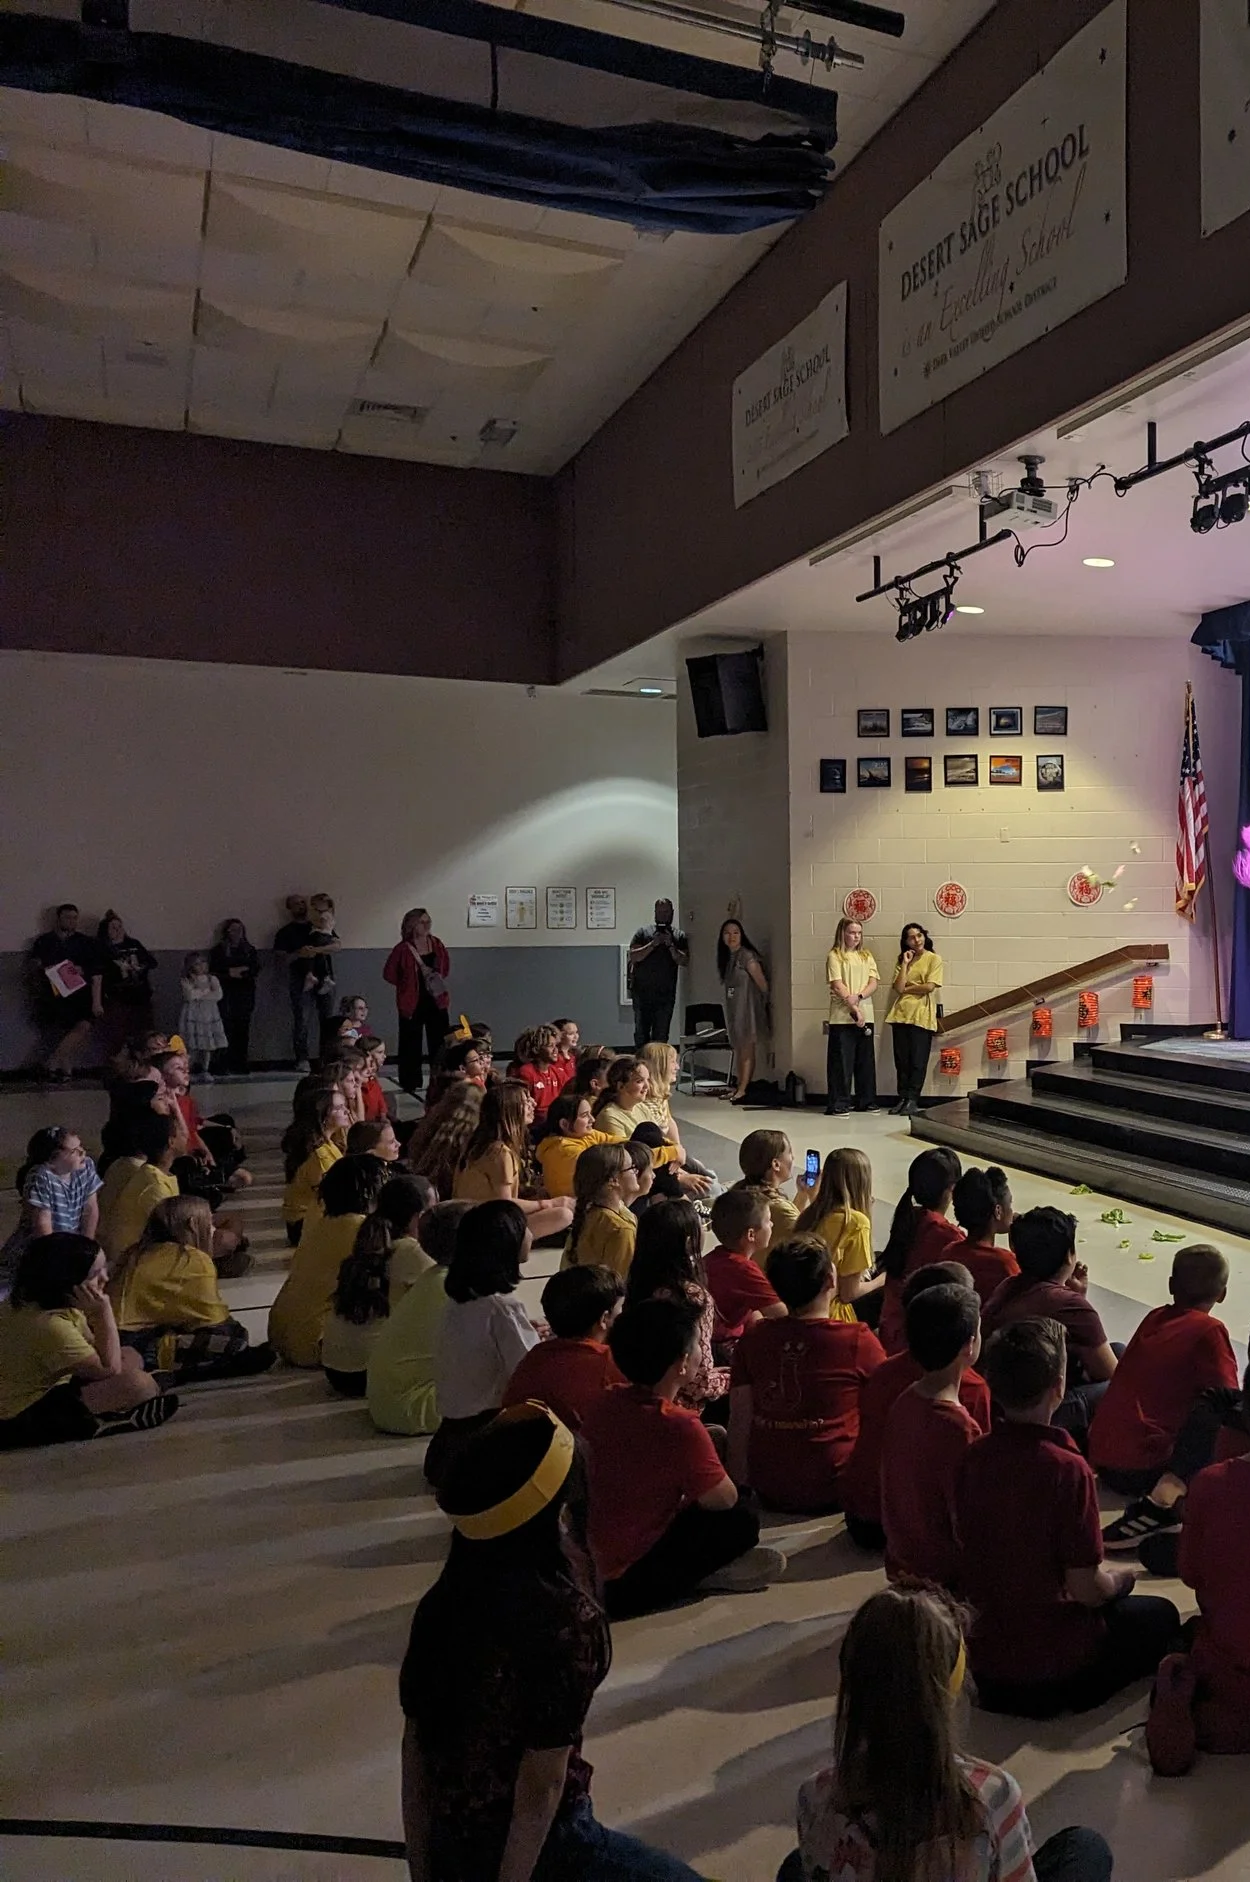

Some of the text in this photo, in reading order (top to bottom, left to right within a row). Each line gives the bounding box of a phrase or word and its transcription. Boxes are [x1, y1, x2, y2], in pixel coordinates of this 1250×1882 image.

[901, 123, 1090, 301] DESERT SAGE SCHOOL
[1016, 161, 1088, 276] School
[745, 390, 772, 427] DESERT
[773, 373, 794, 405] SAGE
[795, 344, 832, 387] SCHOOL
